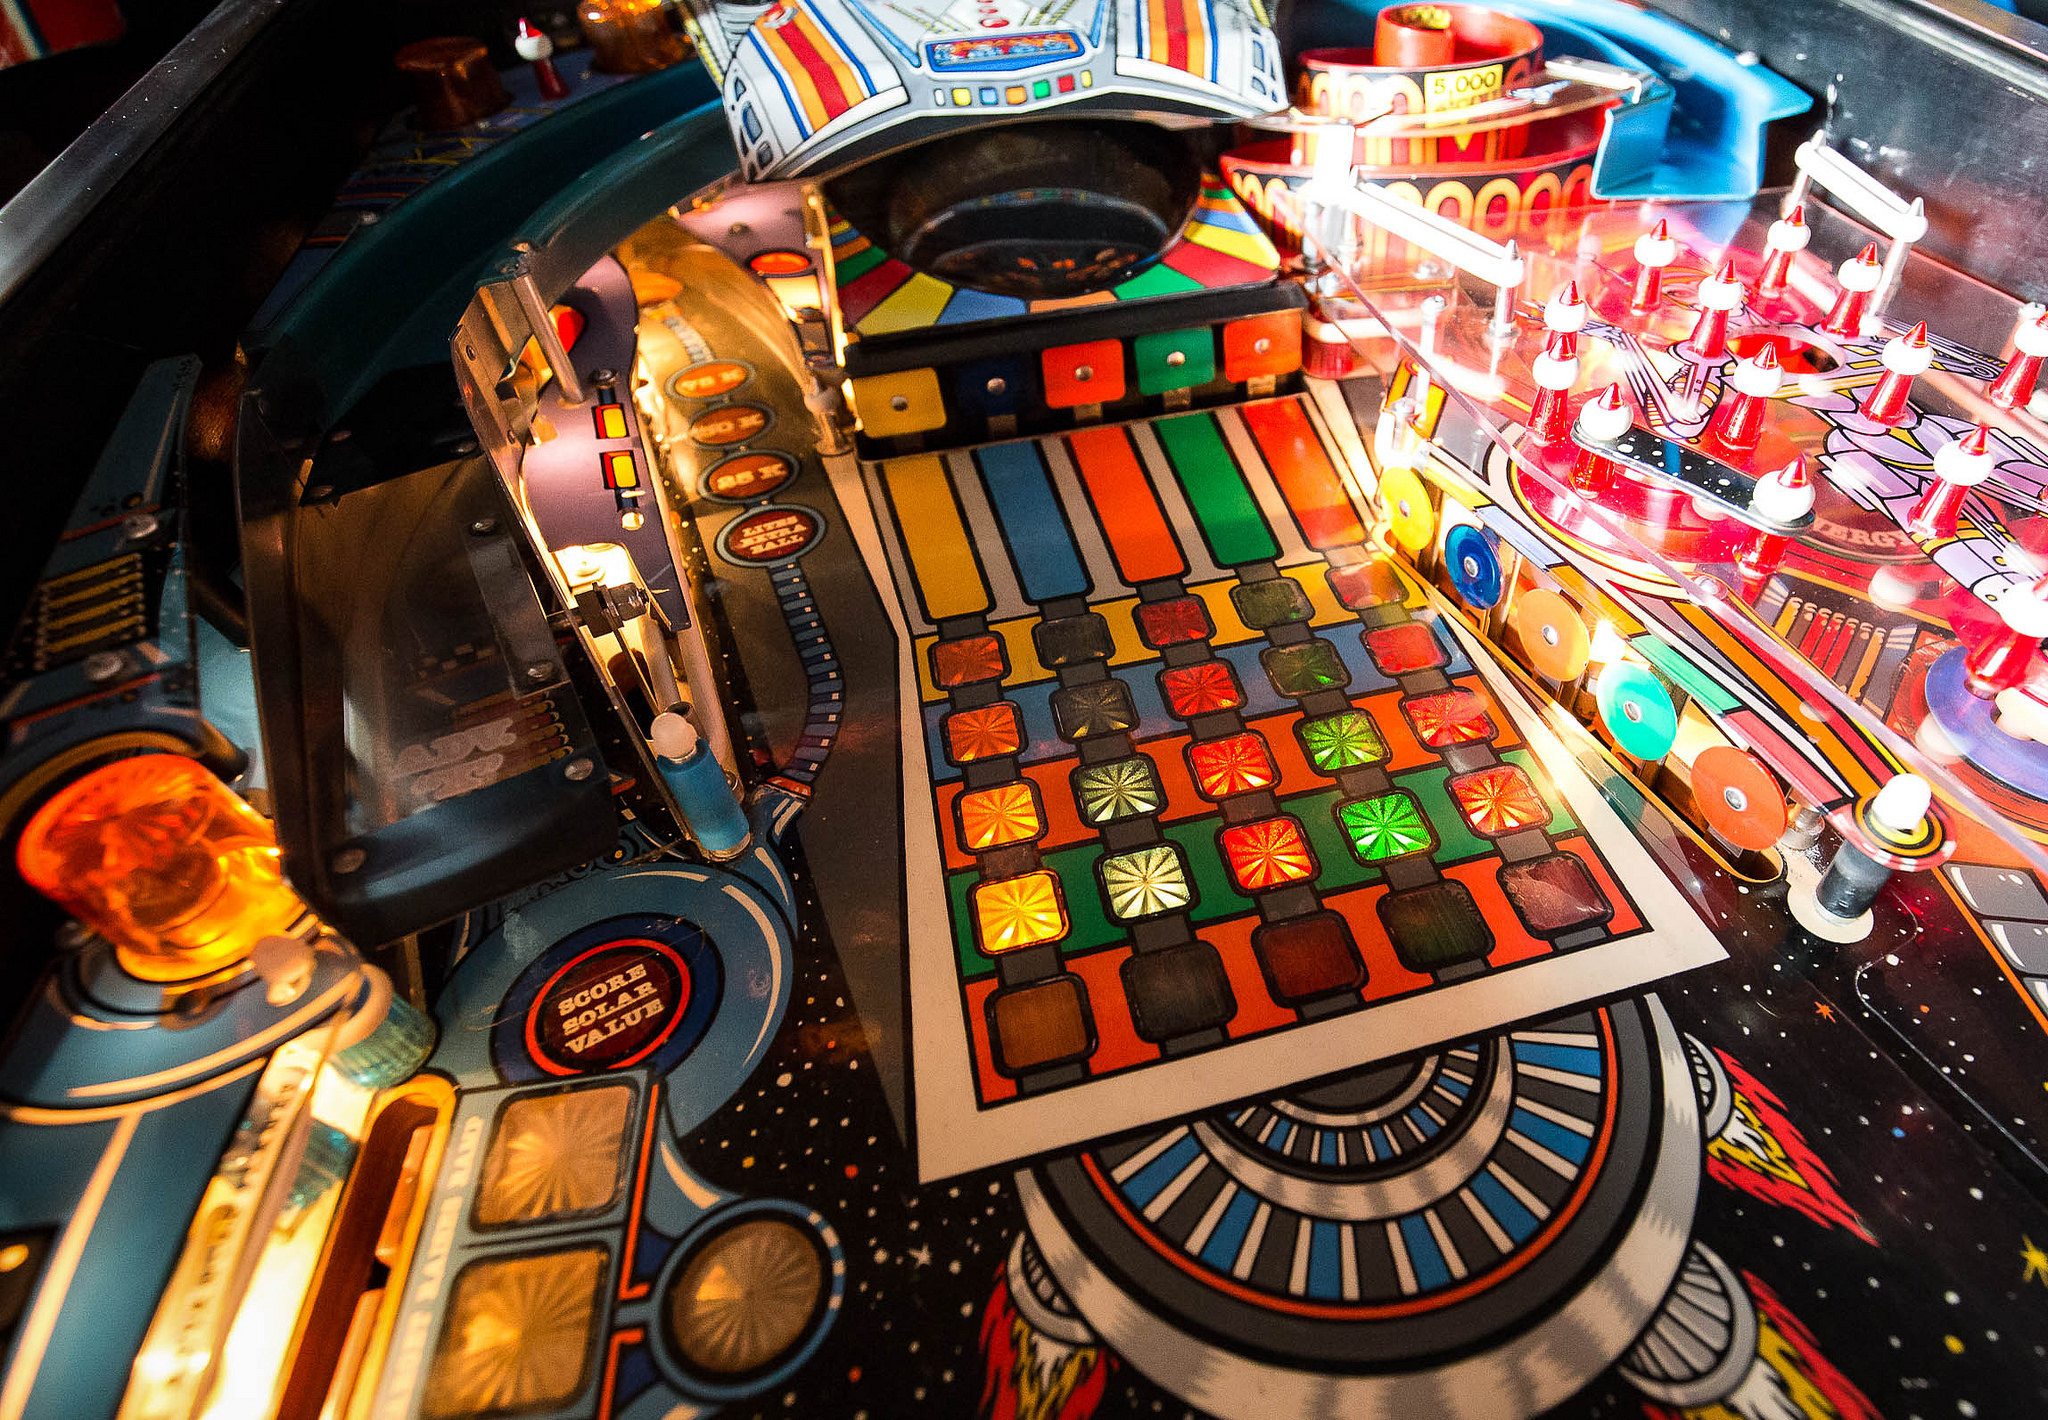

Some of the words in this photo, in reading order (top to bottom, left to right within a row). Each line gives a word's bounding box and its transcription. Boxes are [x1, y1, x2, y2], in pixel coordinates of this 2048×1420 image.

[1434, 71, 1496, 96] 5,000
[739, 523, 806, 549] EXTRA
[749, 534, 804, 555] BALL
[558, 963, 647, 1016] SCORE
[562, 982, 657, 1036] SOLAR
[564, 998, 665, 1053] VALUE
